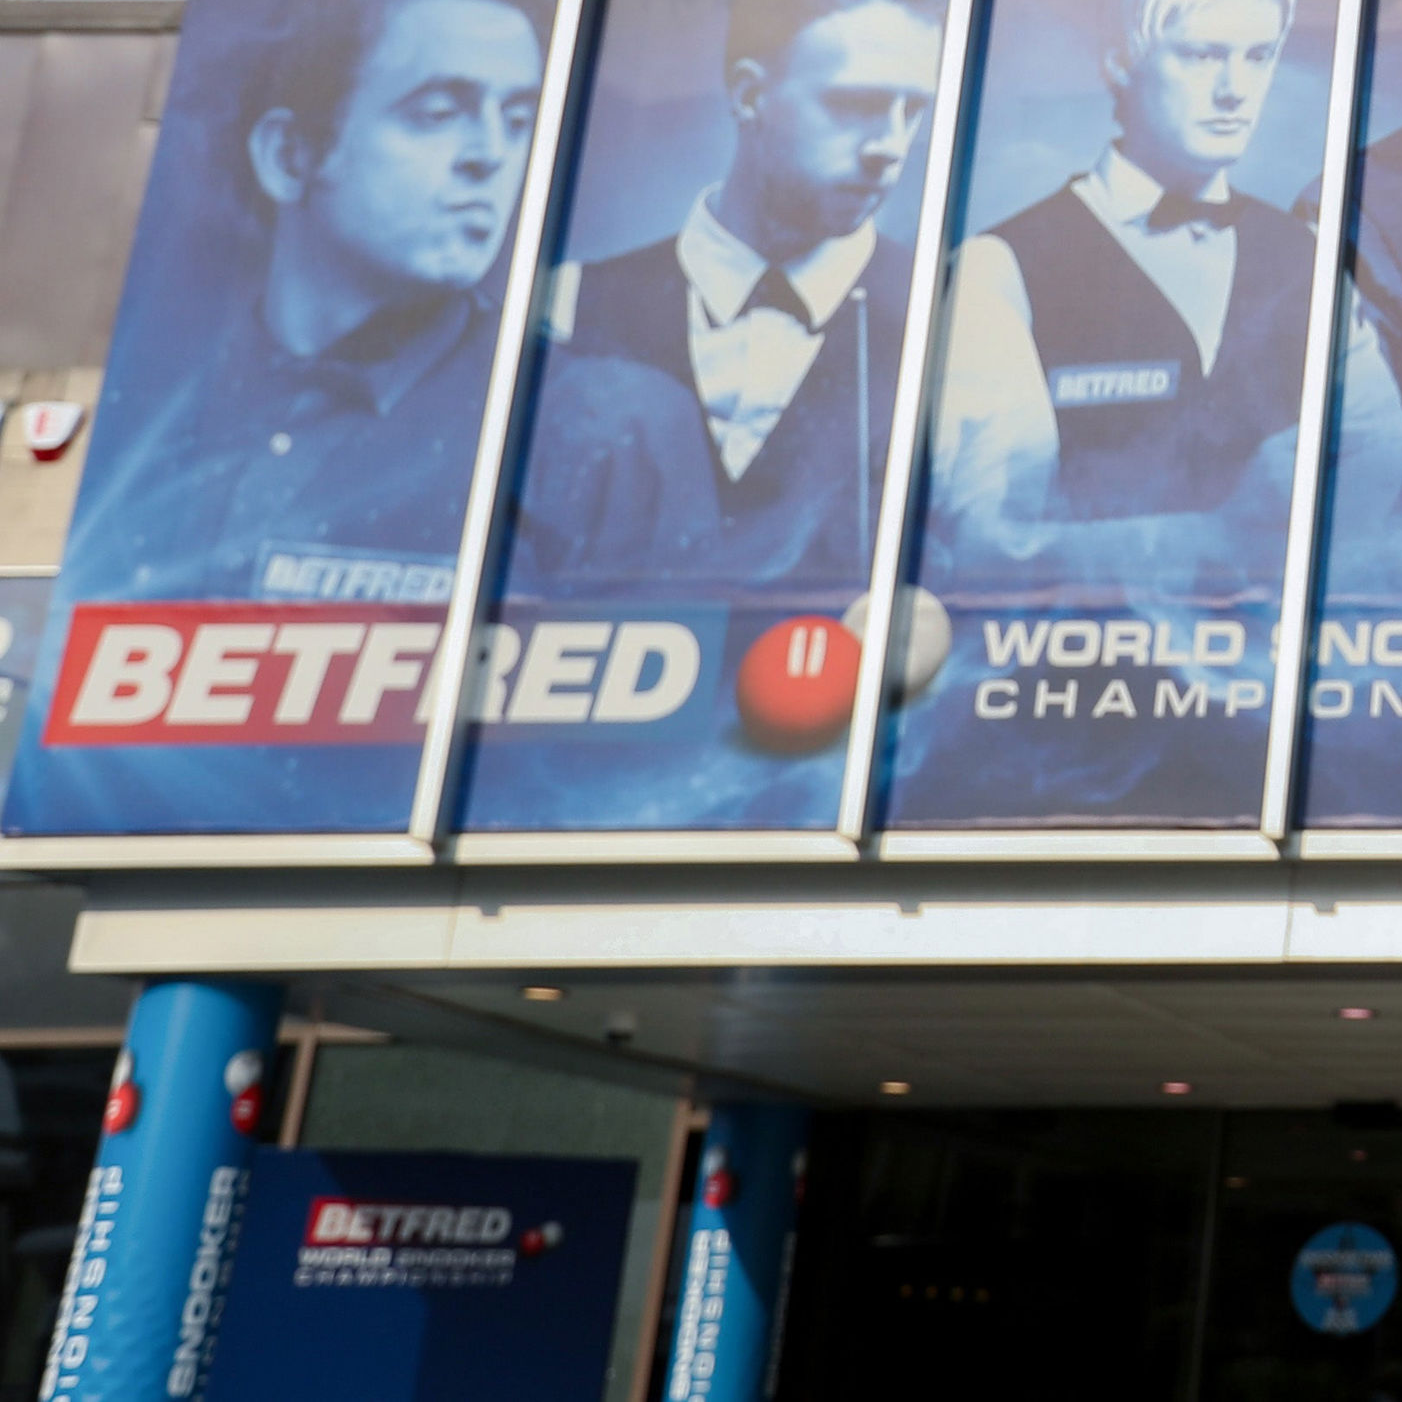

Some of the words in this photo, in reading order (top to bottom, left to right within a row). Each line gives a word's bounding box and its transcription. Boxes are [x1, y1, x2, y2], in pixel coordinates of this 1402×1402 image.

[1056, 367, 1170, 399] BETFRED
[984, 619, 1245, 668] WORLD
[312, 1202, 514, 1245] BETFRED
[166, 1166, 239, 1398] SNOOKER
